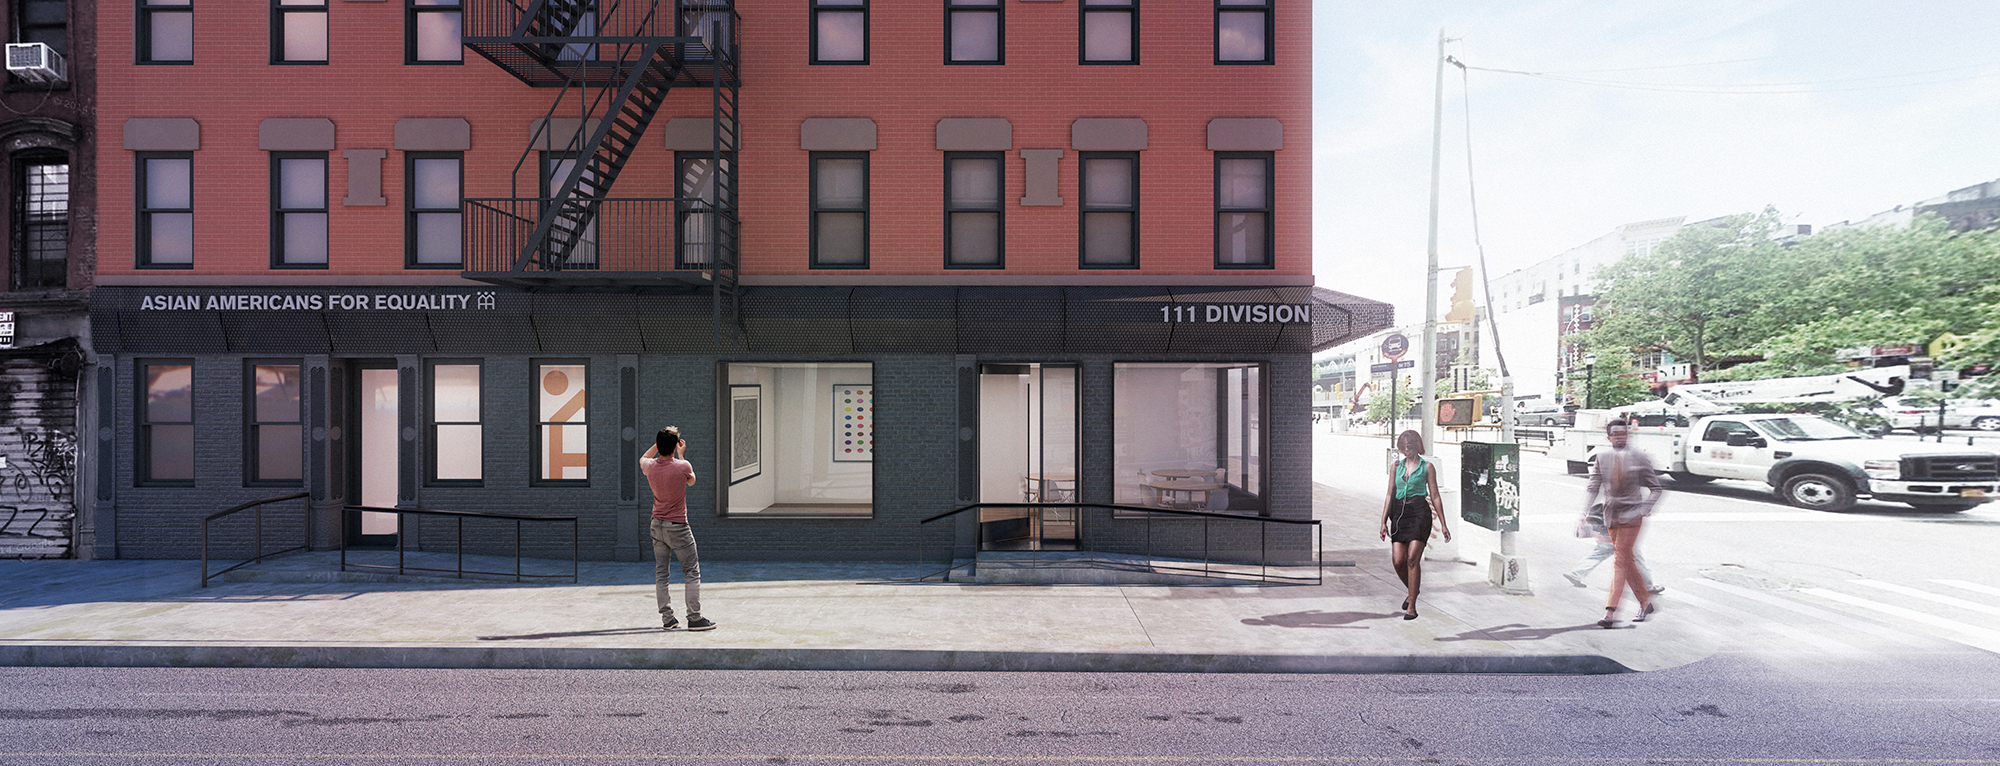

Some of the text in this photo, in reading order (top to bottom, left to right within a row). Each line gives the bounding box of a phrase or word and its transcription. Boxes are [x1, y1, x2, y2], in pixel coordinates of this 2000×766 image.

[140, 294, 471, 310] ASIAN AMERICANS FOR EQUALITY
[1161, 305, 1310, 323] 111 DIVISION
